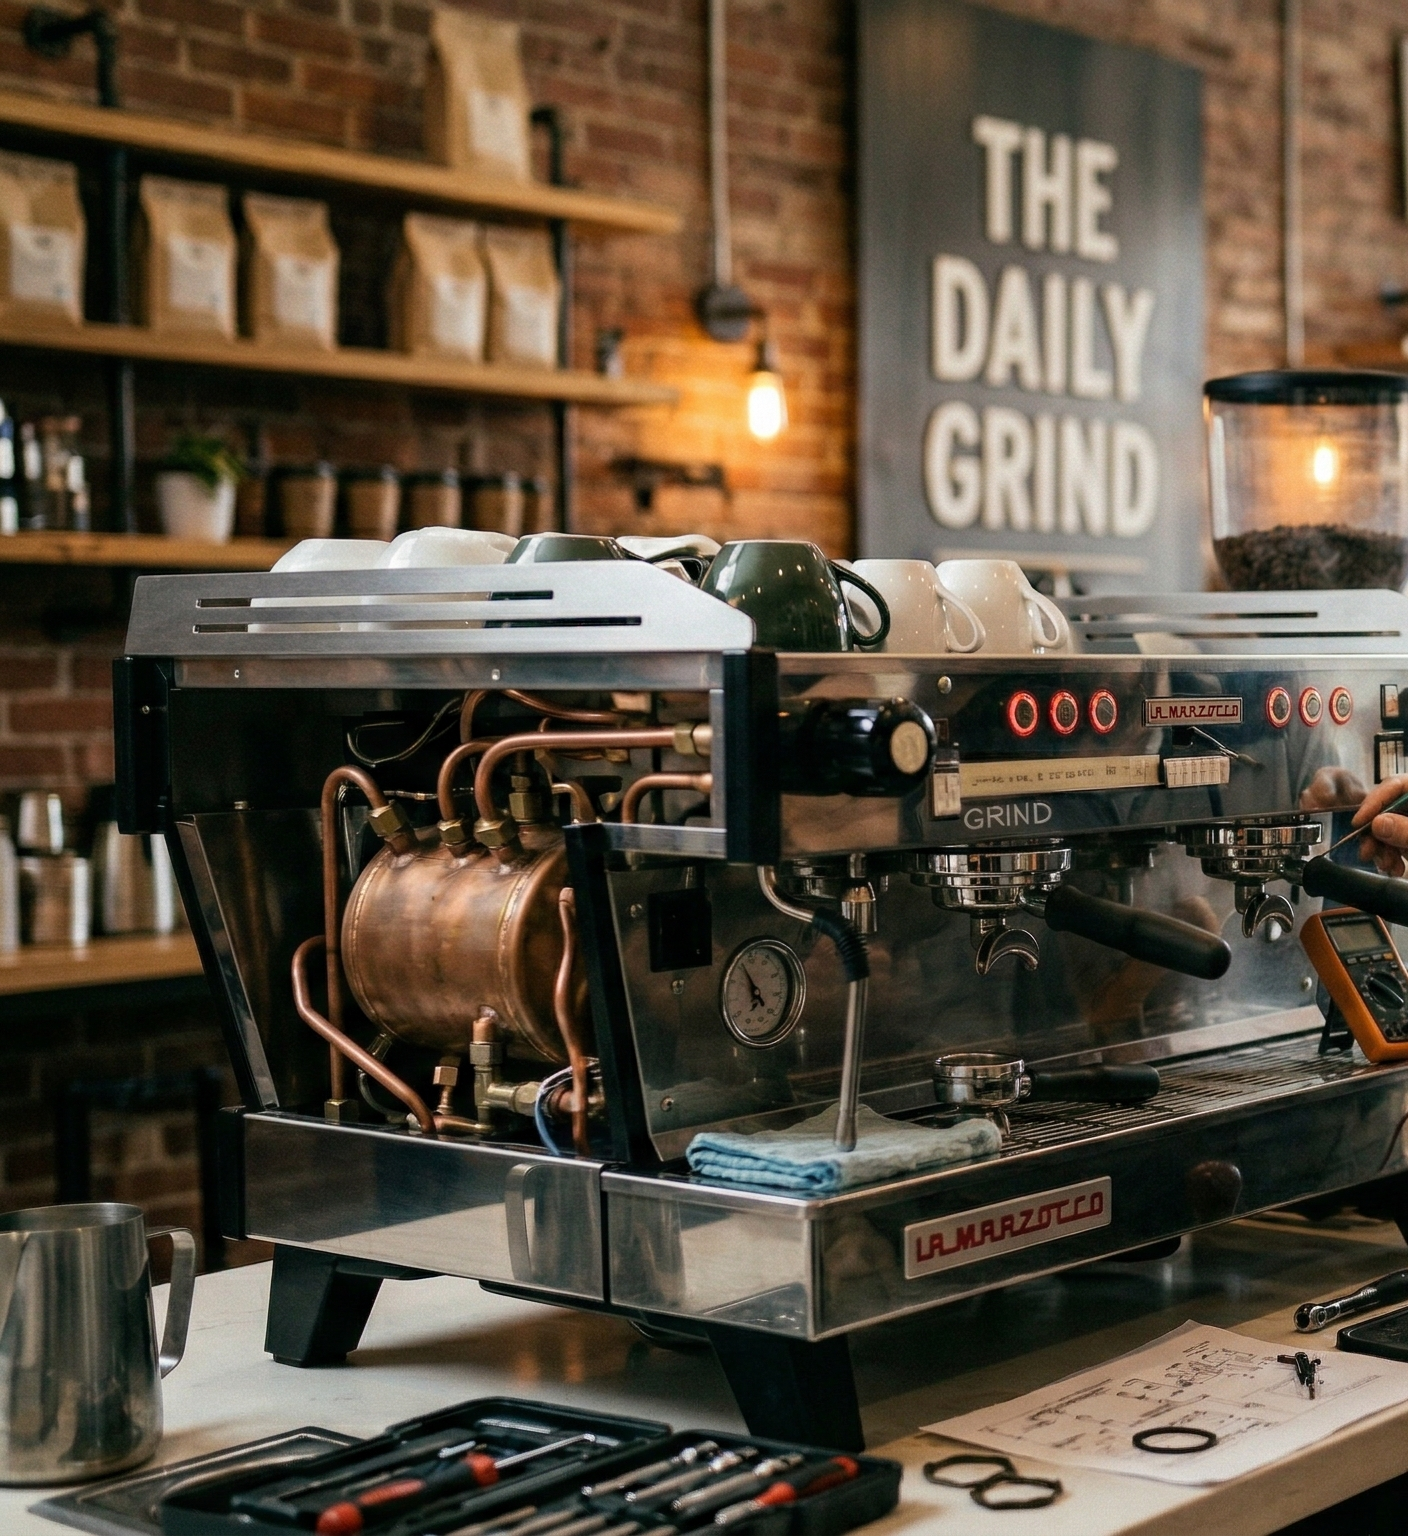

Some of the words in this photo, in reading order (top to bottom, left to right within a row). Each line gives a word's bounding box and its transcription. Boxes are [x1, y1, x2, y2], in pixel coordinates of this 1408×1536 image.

[972, 114, 1119, 262] THE
[931, 253, 1154, 399] DAILY
[924, 402, 1160, 538] GRIND
[963, 802, 1052, 830] GRIND
[916, 1232, 958, 1263] LA
